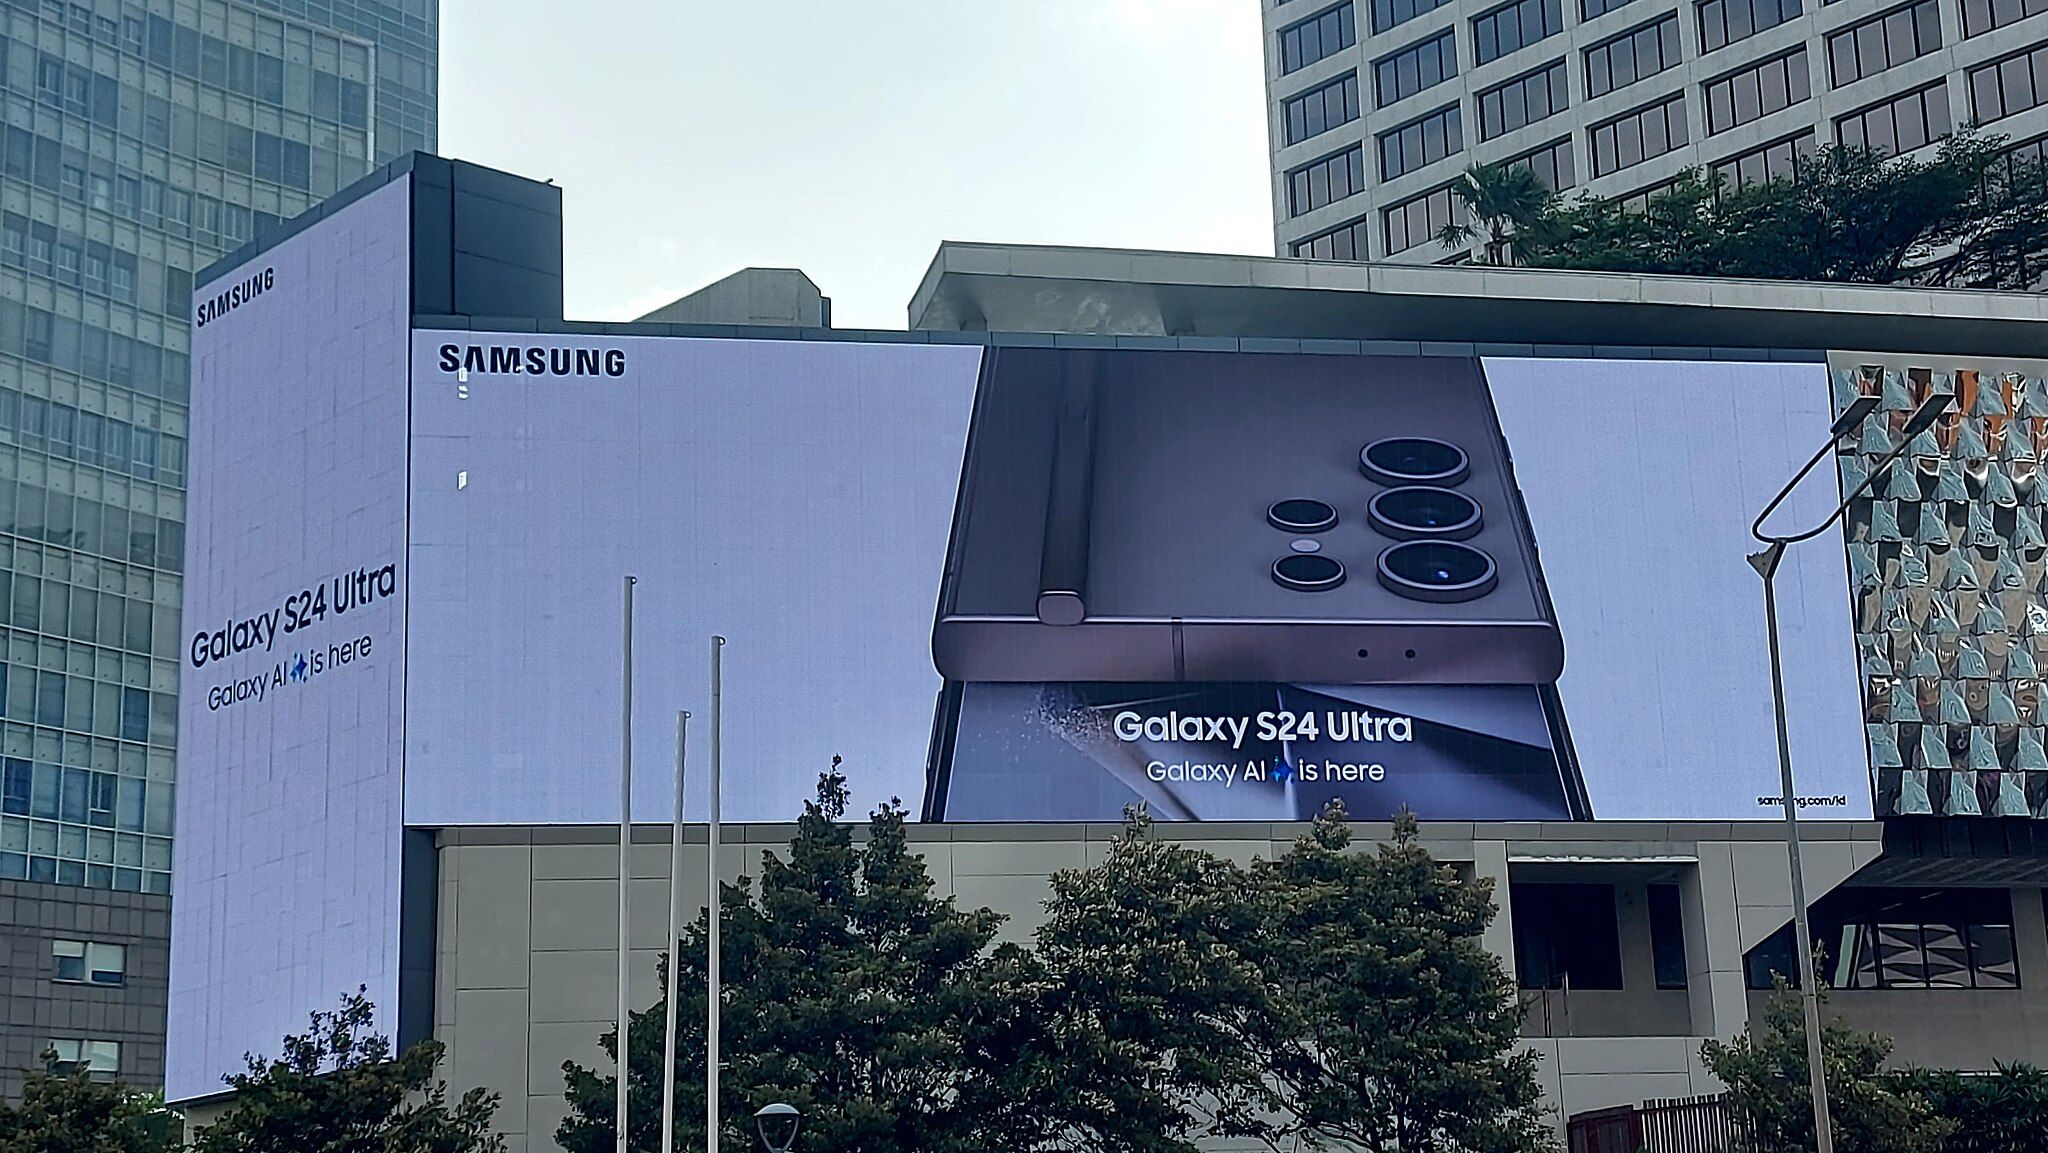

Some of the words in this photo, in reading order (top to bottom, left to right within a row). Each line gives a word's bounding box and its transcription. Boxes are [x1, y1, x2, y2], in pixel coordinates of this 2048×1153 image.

[197, 267, 274, 327] SAMSUNG
[439, 343, 626, 377] SAMSUNG
[191, 608, 280, 668] Galaxy
[284, 584, 327, 633] S24
[334, 563, 396, 614] Ultra
[208, 672, 268, 711] Galaxy
[271, 661, 287, 690] AI
[310, 650, 323, 676] is
[328, 635, 372, 669] here
[1114, 711, 1248, 749] Galaxy
[1257, 712, 1319, 741] S24
[1328, 711, 1412, 741] Ultra
[1147, 761, 1236, 787] Galaxy
[1243, 762, 1265, 781] AI
[1300, 759, 1318, 781] is
[1326, 760, 1385, 781] here
[1757, 795, 1846, 808] samsng.com/id
